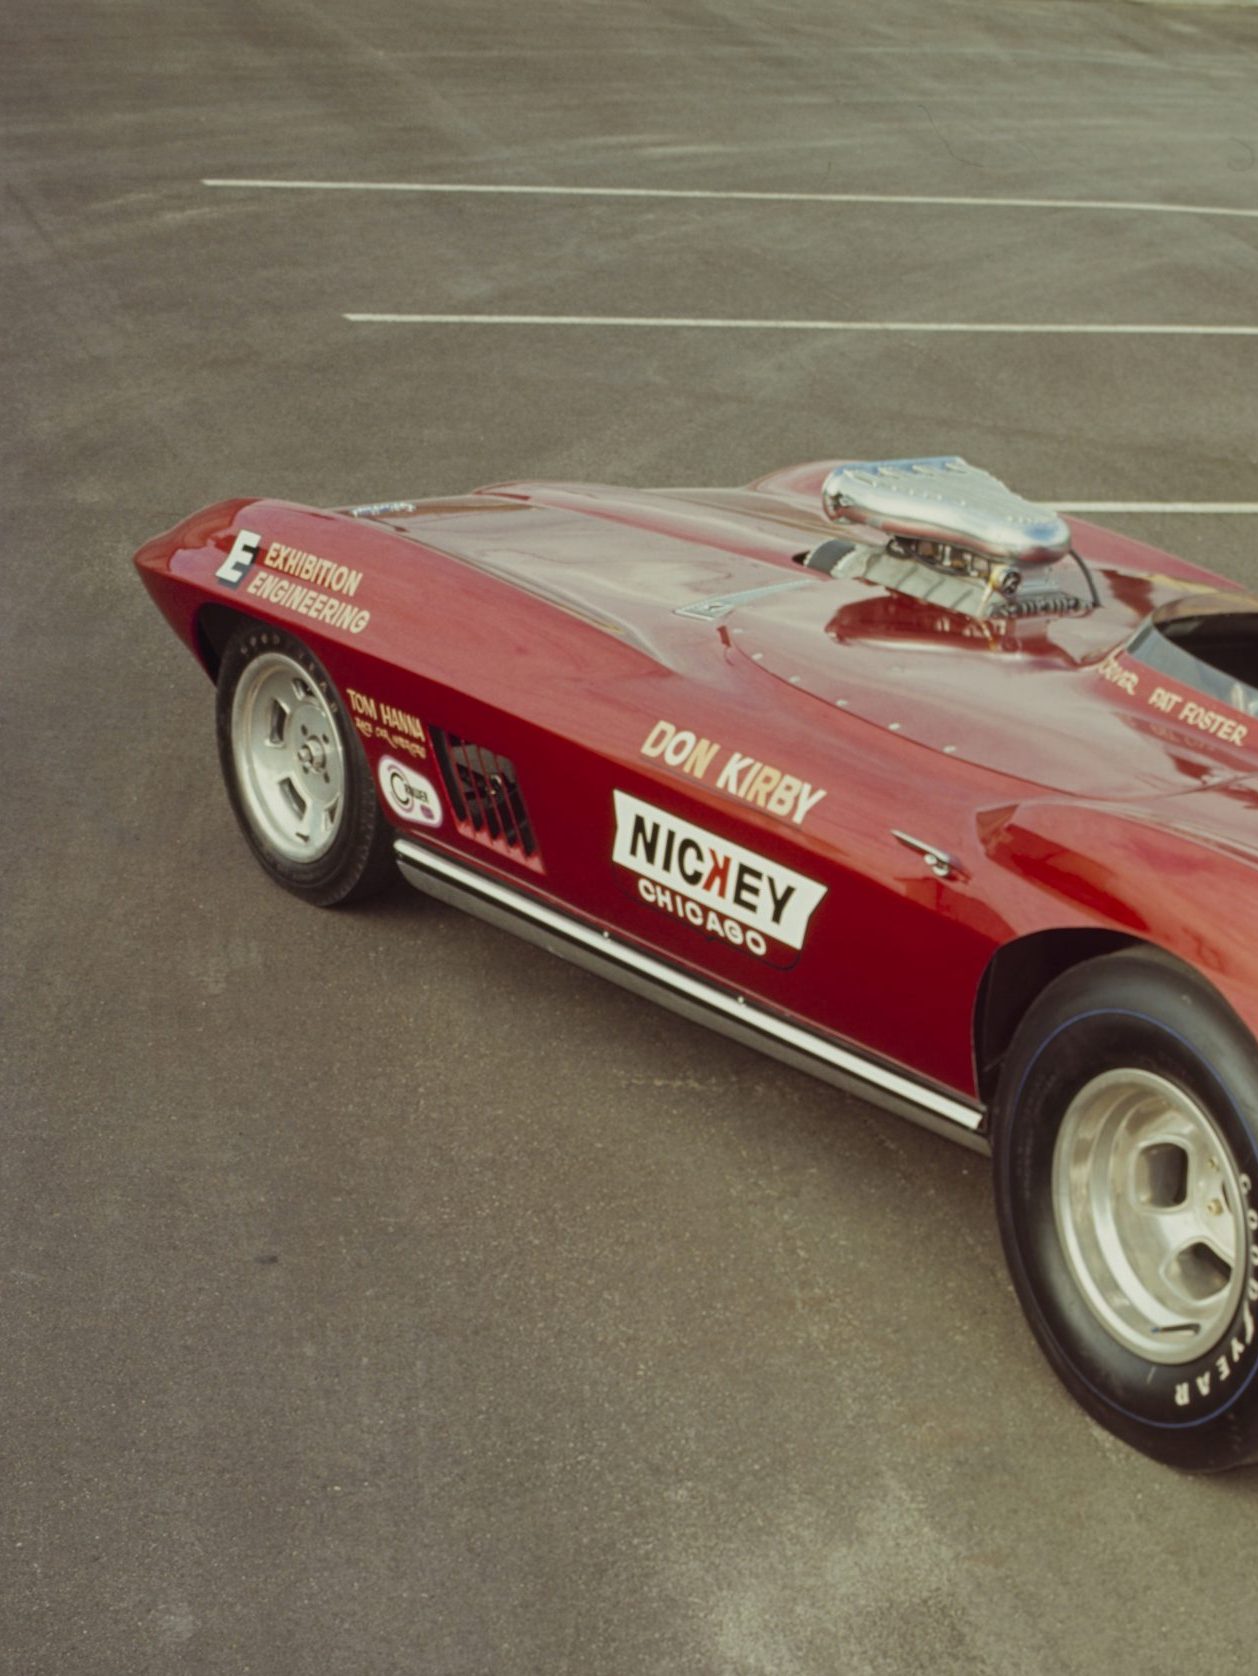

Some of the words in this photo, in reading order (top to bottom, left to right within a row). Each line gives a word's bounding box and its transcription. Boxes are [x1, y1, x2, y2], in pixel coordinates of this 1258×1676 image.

[215, 530, 262, 586] E
[264, 543, 363, 596] EXHIBITION
[247, 572, 370, 634] ENGINEERING
[346, 688, 378, 720] TOM
[380, 703, 426, 742] HANNA
[1148, 686, 1183, 714] PAT
[1178, 701, 1248, 746] FOSTER
[640, 720, 721, 780] DON
[716, 752, 827, 825] KIRBY
[630, 814, 796, 925] NICKEY
[638, 879, 767, 956] CHICAGO
